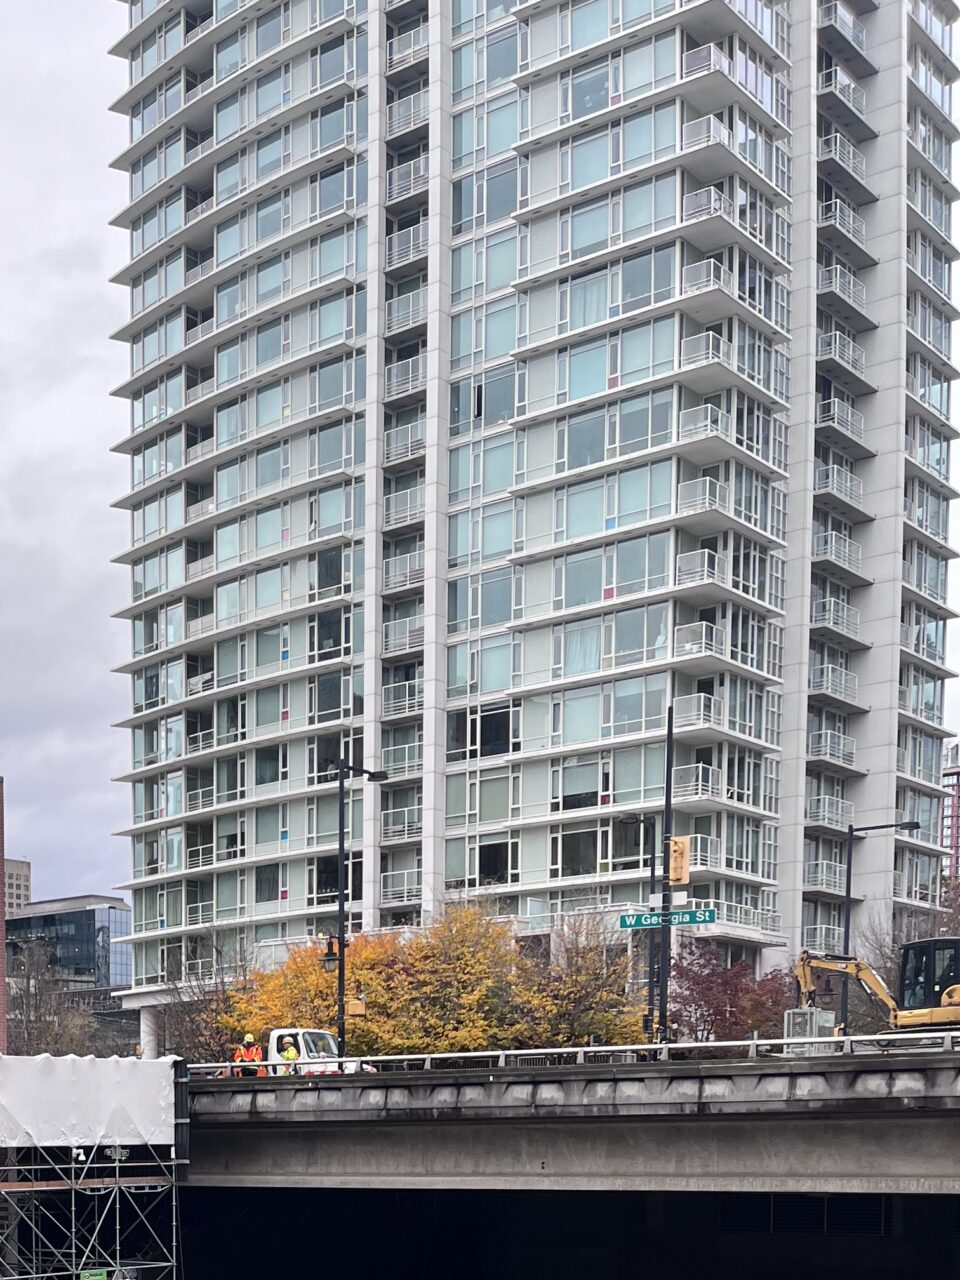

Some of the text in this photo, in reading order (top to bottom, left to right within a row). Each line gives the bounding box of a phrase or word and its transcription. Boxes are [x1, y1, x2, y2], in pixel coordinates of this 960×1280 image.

[625, 911, 710, 926] W Gegia St
